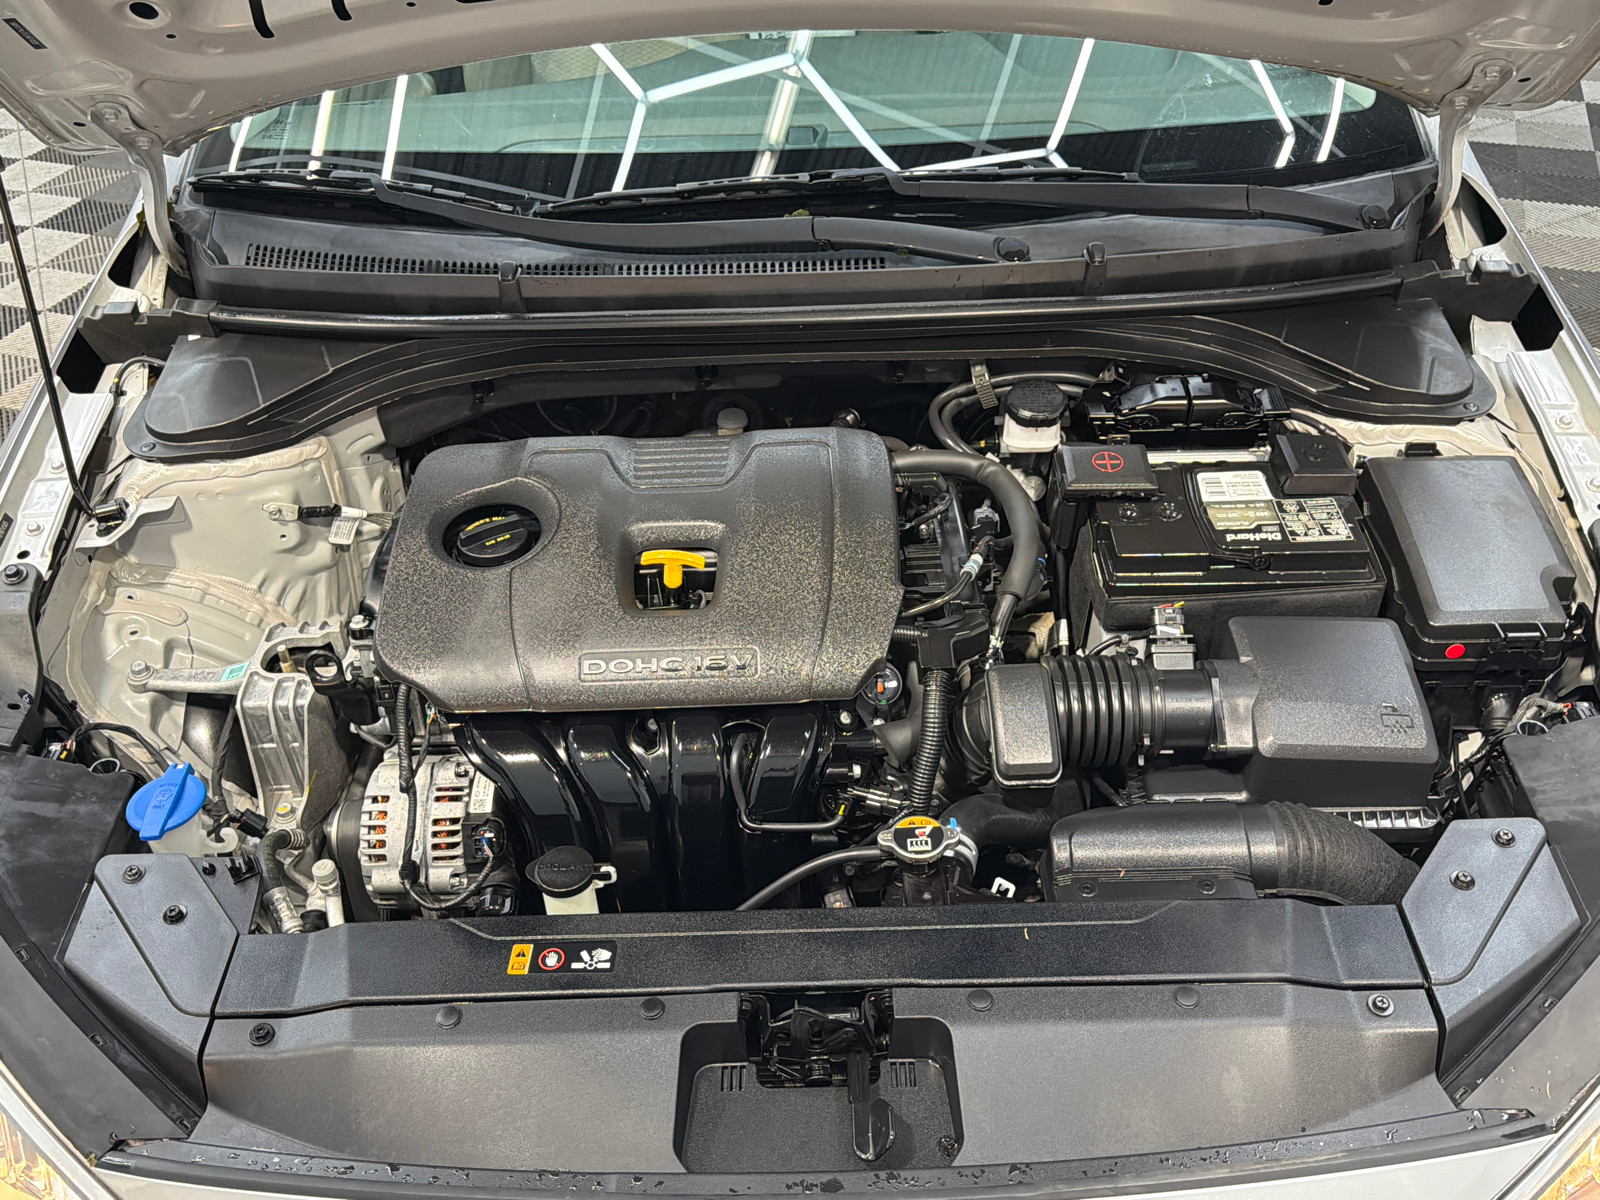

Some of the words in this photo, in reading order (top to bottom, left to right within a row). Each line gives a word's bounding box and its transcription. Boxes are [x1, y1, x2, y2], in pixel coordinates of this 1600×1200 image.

[1226, 532, 1282, 542] DieHard
[583, 657, 684, 675] DOHC
[694, 654, 754, 671] 16V
[537, 863, 592, 871] COOLANT
